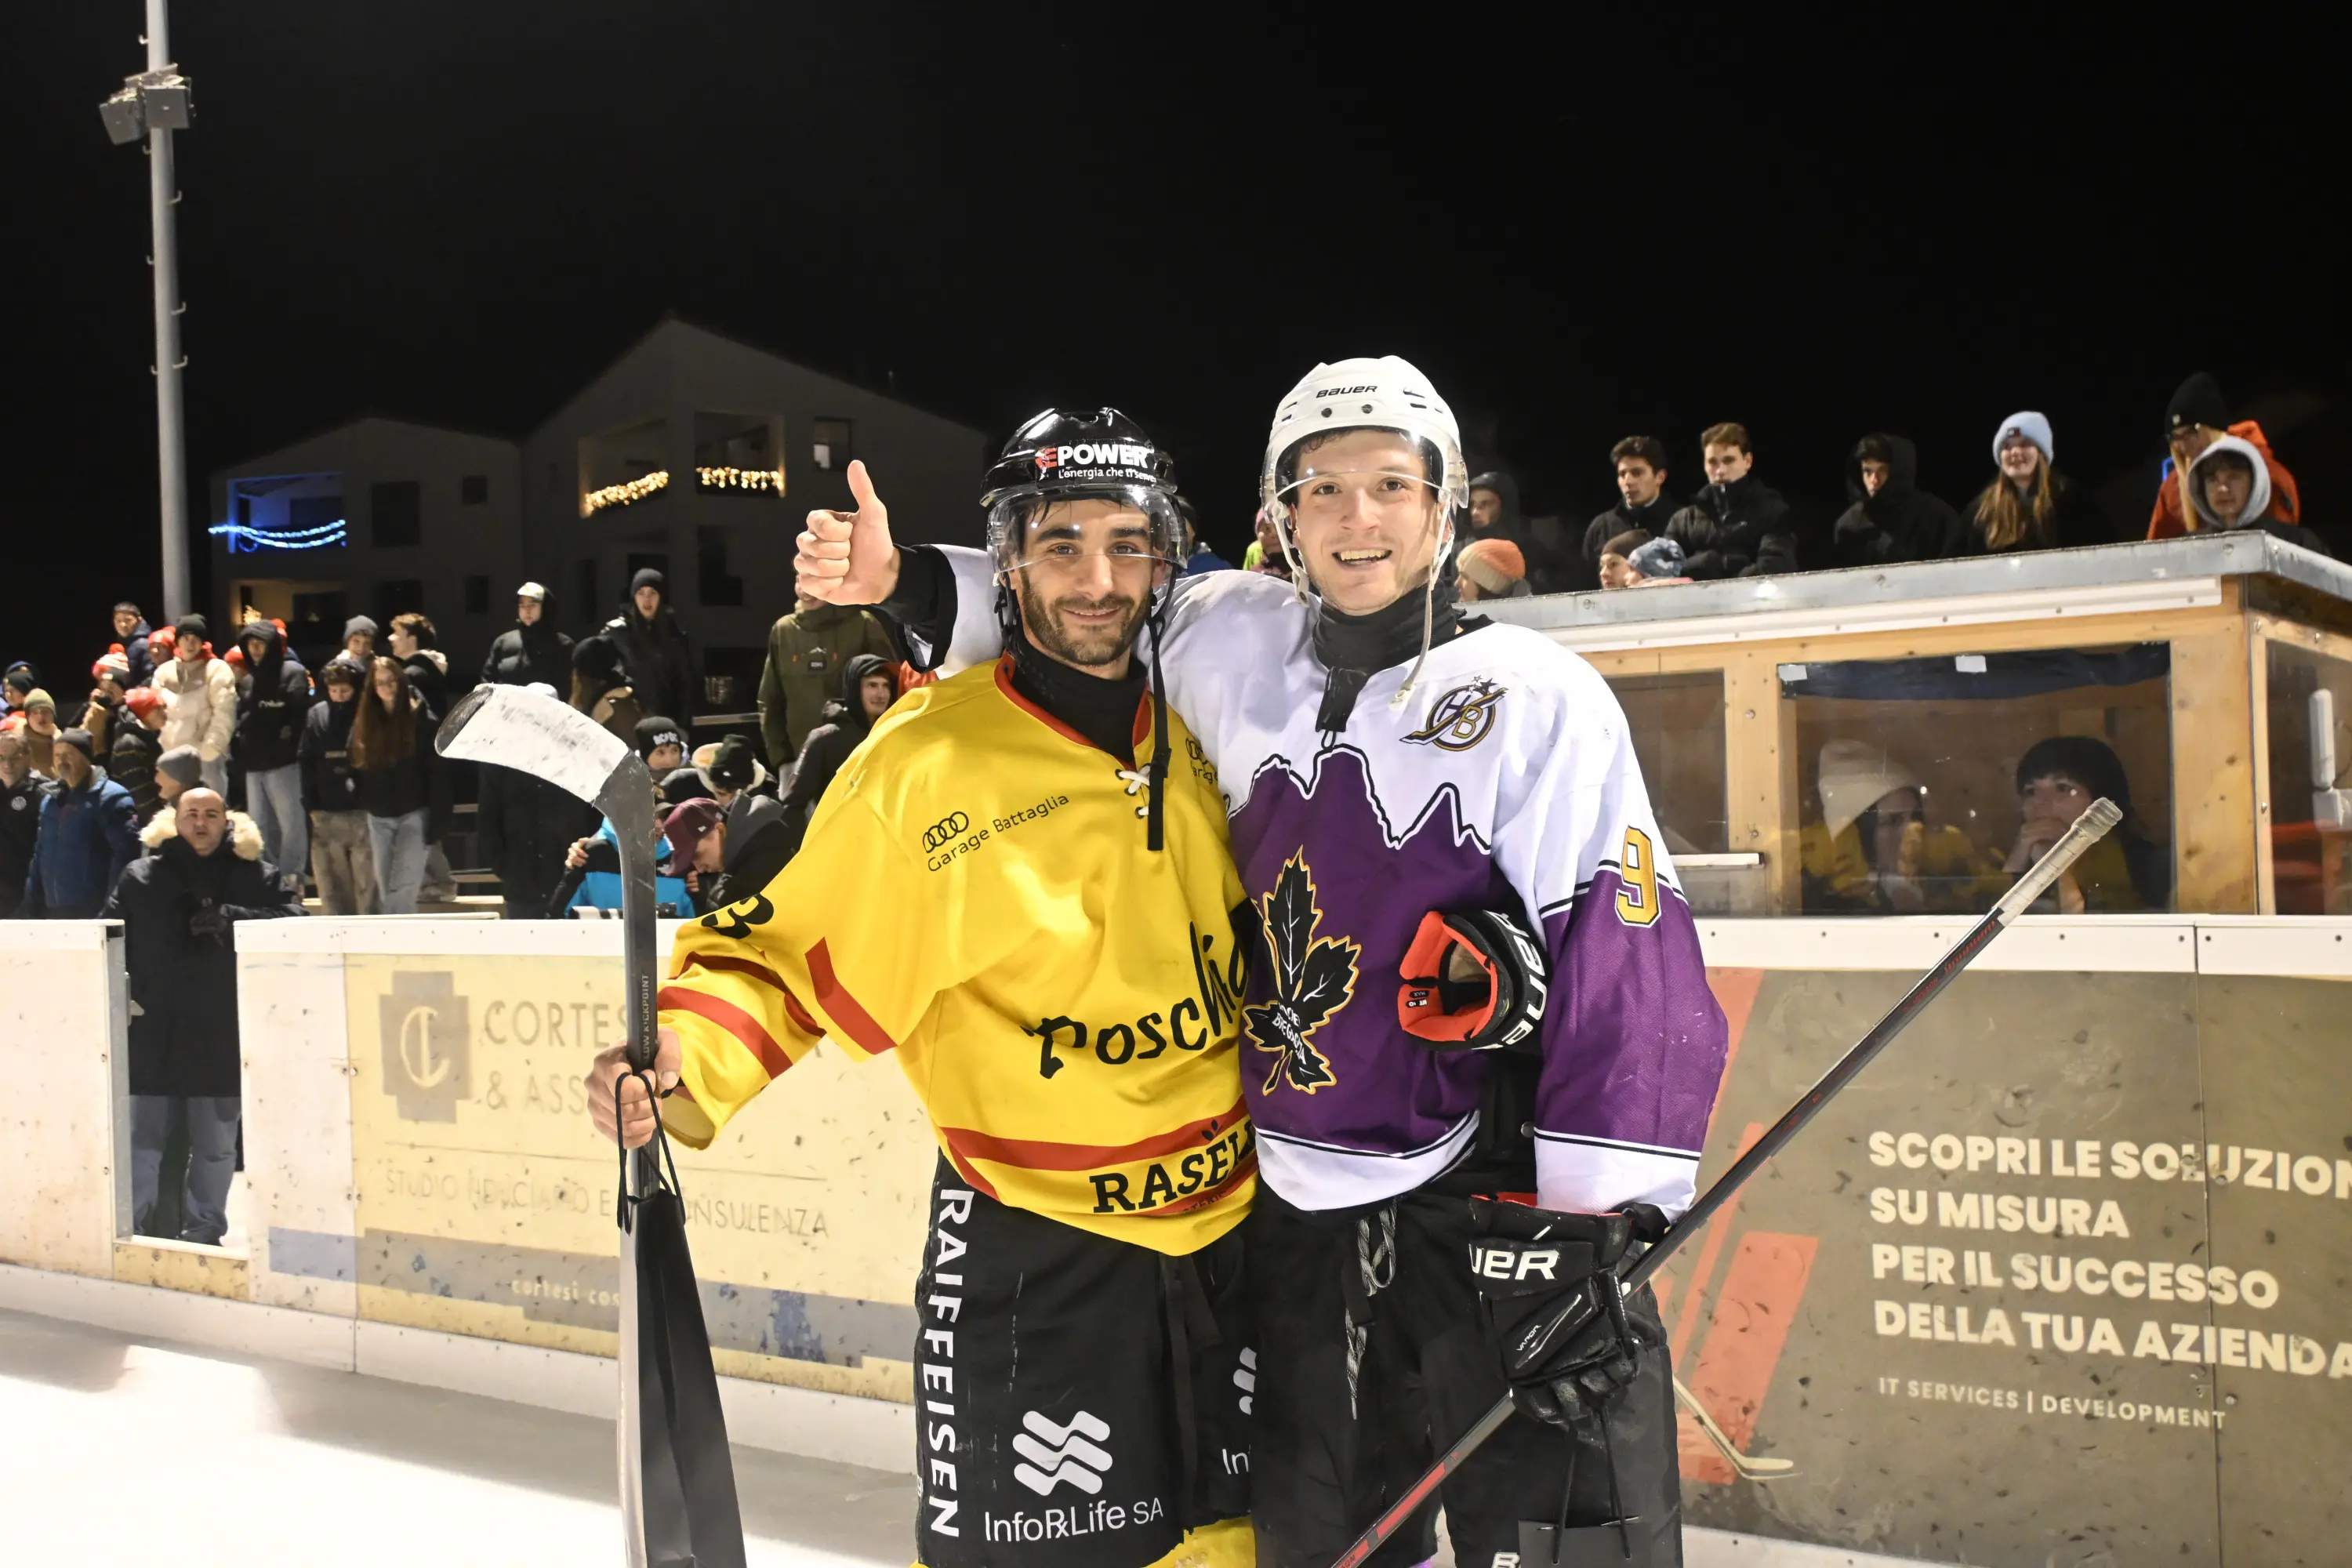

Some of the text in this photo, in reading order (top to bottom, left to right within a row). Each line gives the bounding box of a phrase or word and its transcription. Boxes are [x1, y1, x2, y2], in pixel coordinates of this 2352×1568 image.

[1316, 386, 1377, 398] BAUER
[1106, 466, 1123, 477] che
[927, 795, 1069, 872] Garage Battaglia
[1614, 826, 1661, 927] 9
[486, 1070, 508, 1110] &
[1869, 1131, 2040, 1175] SCOPRI
[2052, 1139, 2101, 1177] LE
[600, 1189, 611, 1216] E
[1870, 1188, 2130, 1238] SU MISURA
[1872, 1243, 2279, 1308] PER IL SUCCESSO
[1875, 1299, 2016, 1346] DELLA
[2021, 1311, 2125, 1356] TUA
[923, 1189, 975, 1537] RAIFFEISEN
[1879, 1377, 1899, 1396] IT
[1907, 1380, 2018, 1409] SERVICES
[2042, 1395, 2226, 1429] DEVELOPMENT
[1133, 1497, 1163, 1525] SA
